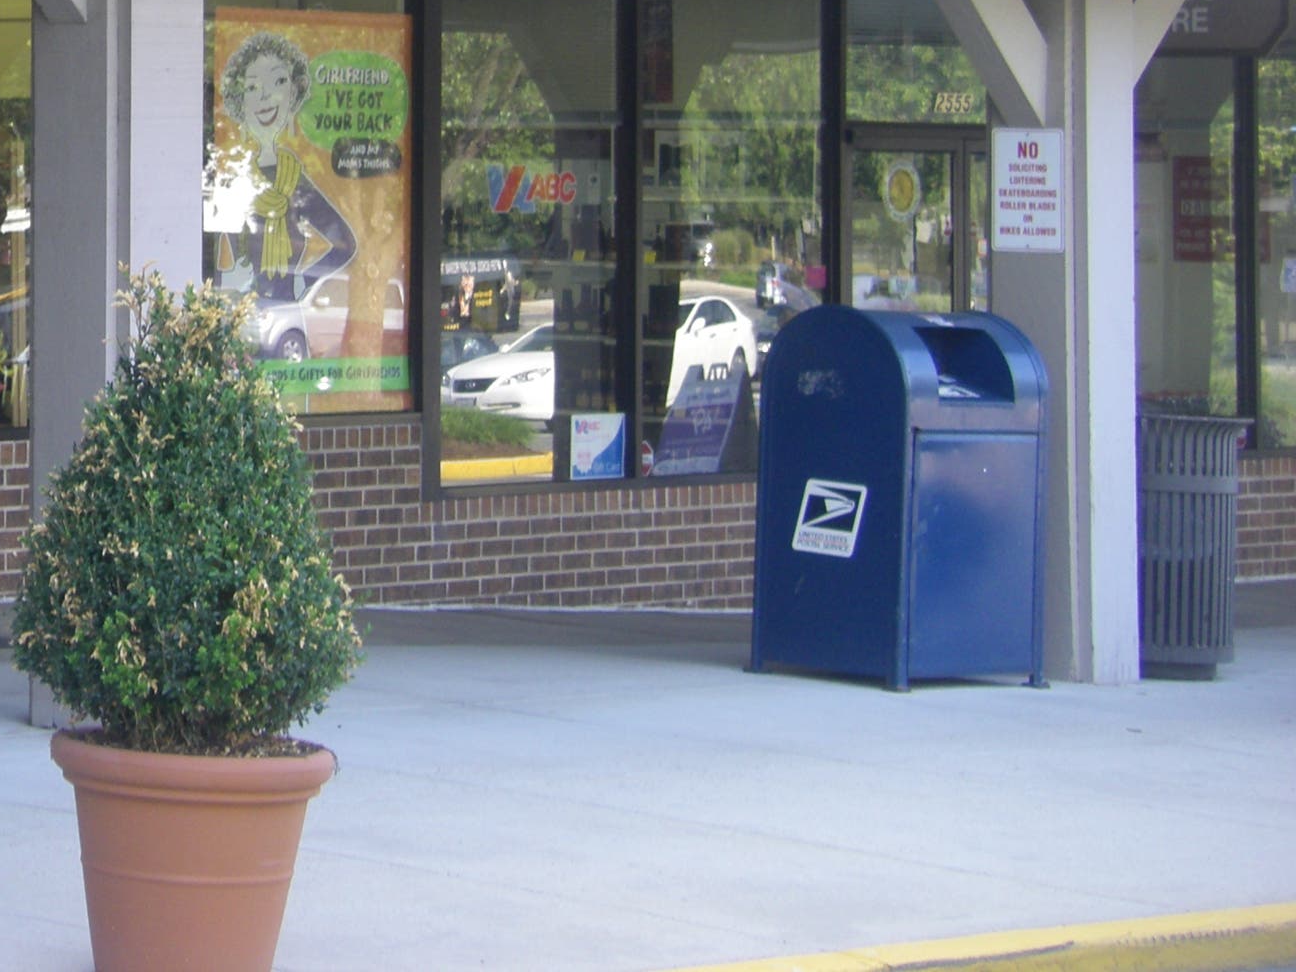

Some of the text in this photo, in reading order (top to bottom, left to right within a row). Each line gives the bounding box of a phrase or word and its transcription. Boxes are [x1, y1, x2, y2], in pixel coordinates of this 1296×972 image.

[315, 65, 390, 85] GIRLFRIEND
[357, 89, 384, 109] GOT
[313, 111, 393, 133] YOUR BACK
[1017, 141, 1039, 159] NO
[1008, 163, 1048, 173] SOLICITING
[526, 171, 577, 204] ABC
[1009, 176, 1046, 186] LOITERING
[998, 188, 1057, 198] SKATEBOARDING
[1000, 201, 1056, 212] ROLLER BLADES
[1022, 226, 1057, 237] ALLOWED
[298, 367, 324, 381] GIFTS
[328, 366, 343, 380] FOR
[345, 365, 401, 380] GIRLFRIENDS
